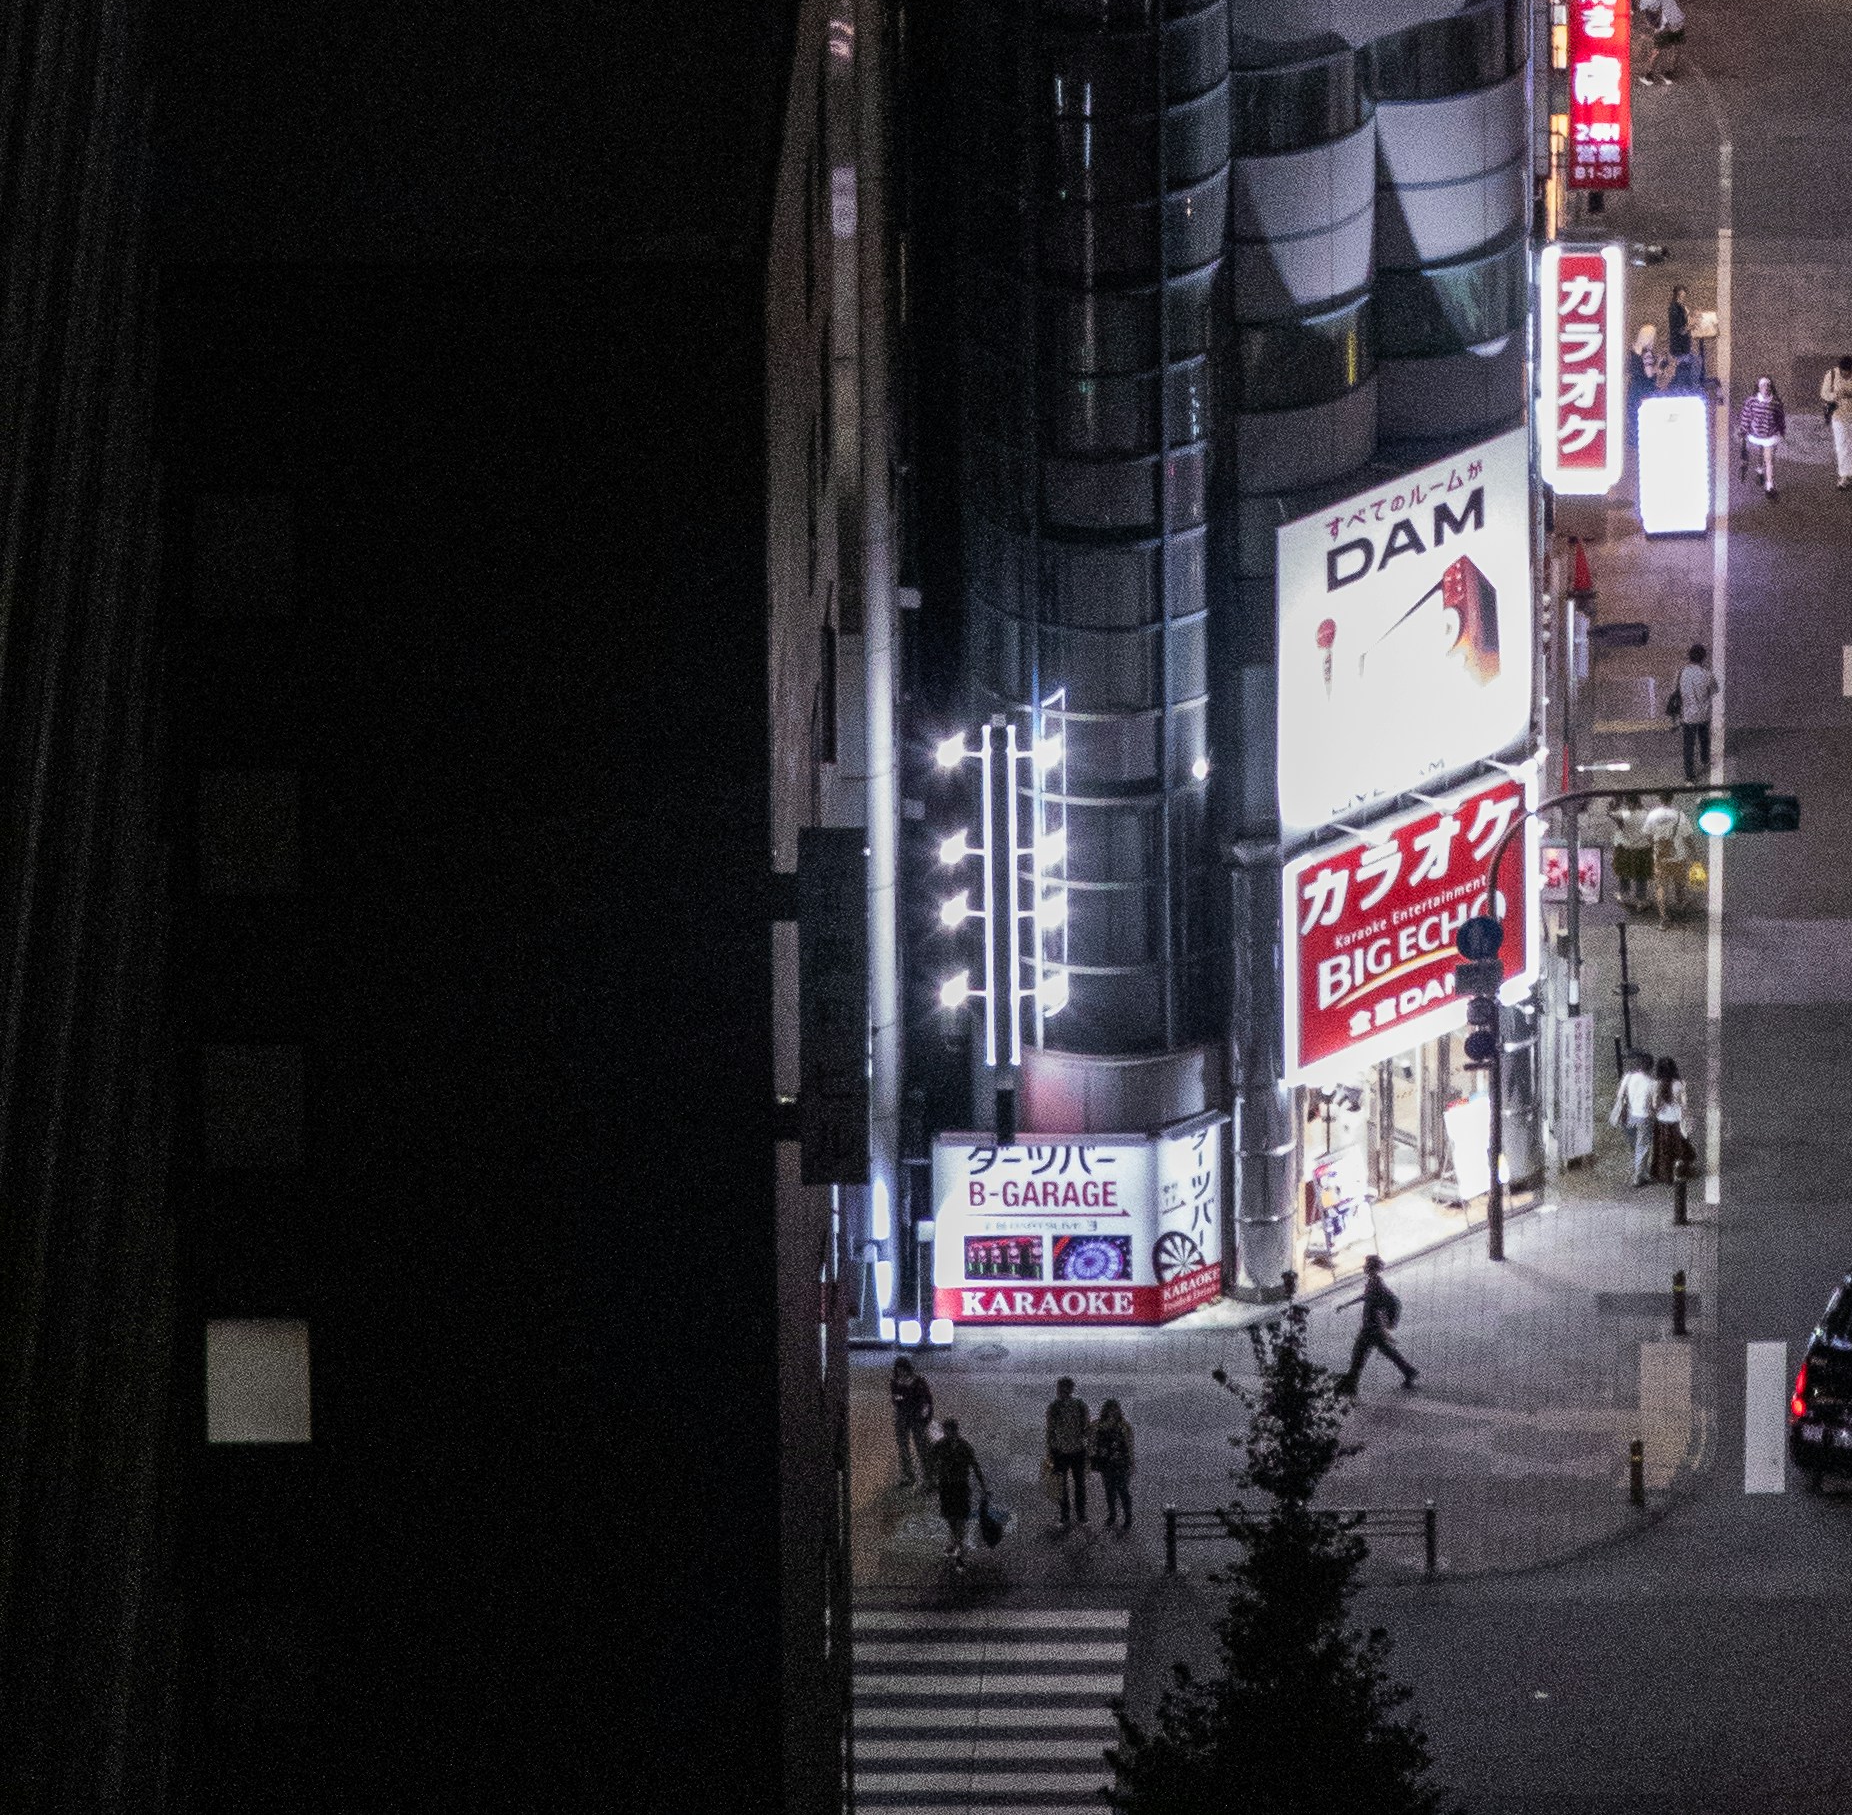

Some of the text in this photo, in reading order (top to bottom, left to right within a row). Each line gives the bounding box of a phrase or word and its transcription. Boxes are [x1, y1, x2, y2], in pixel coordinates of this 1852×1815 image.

[1556, 274, 1608, 457] カラオケ
[1325, 459, 1483, 542] すべてのルームが
[1326, 486, 1486, 594] DAM
[1301, 796, 1520, 937] カラオケ
[1335, 874, 1488, 949] Karaoke Entertainment
[1318, 937, 1391, 1011] BIG
[968, 1180, 1119, 1209] B-GARAGE
[960, 1290, 1135, 1317] KARAOKE
